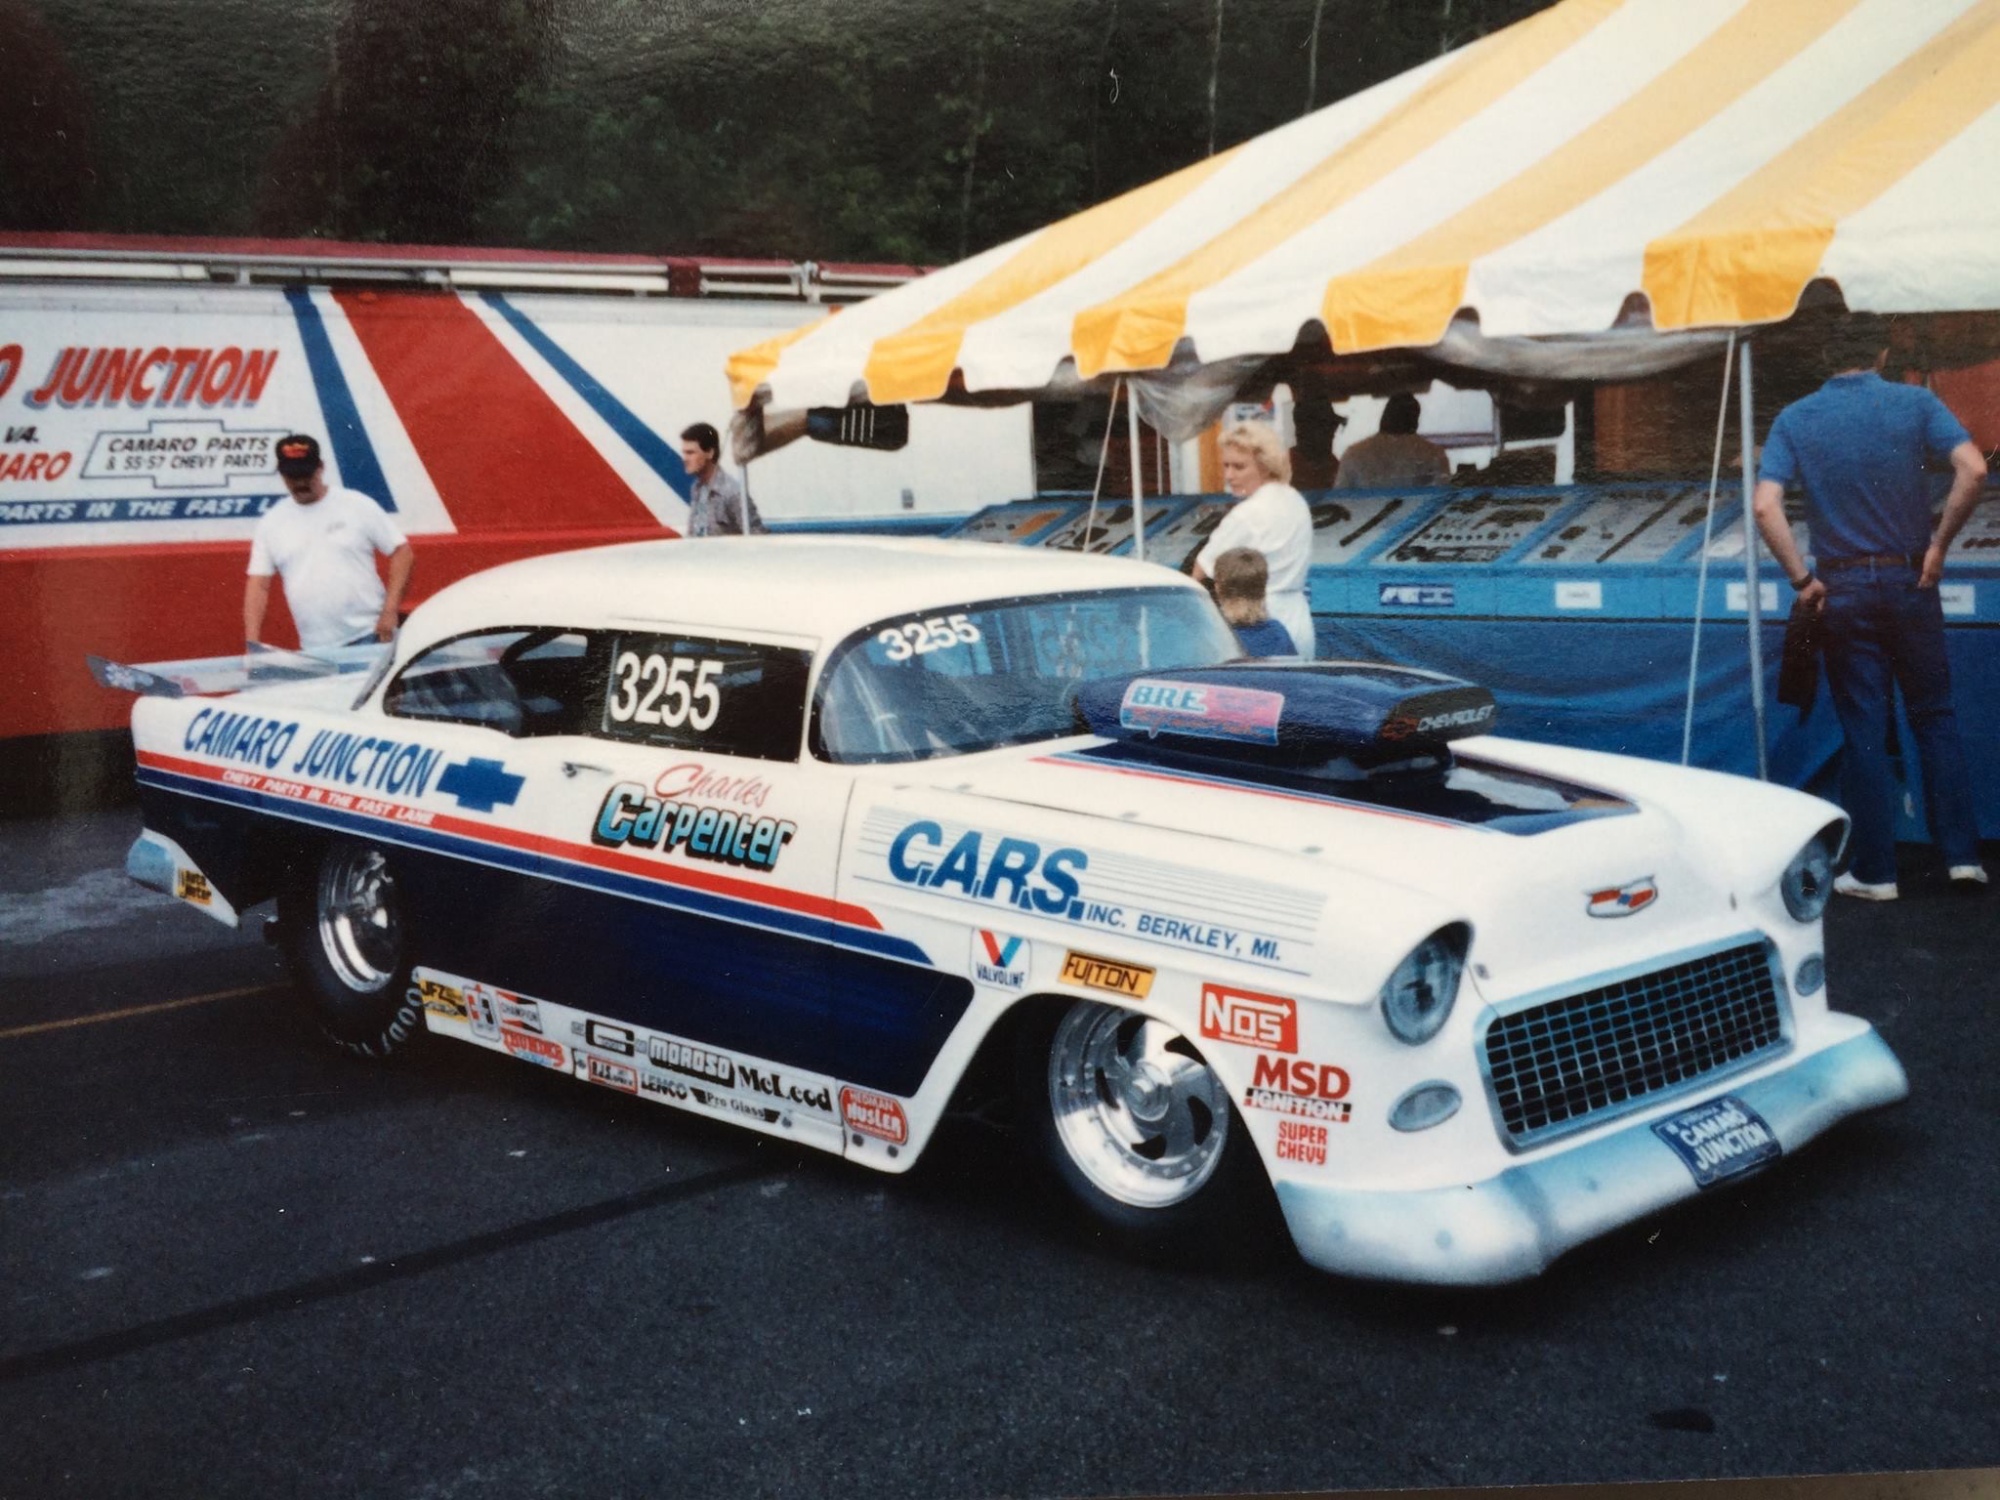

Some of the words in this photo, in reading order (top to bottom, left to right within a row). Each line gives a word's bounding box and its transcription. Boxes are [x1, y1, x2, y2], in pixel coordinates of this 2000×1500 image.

[24, 346, 279, 410] JUNCTION
[105, 456, 116, 470] &
[170, 454, 217, 469] CHEVY
[222, 453, 267, 468] PARTS
[108, 437, 197, 454] CAMARO
[206, 436, 270, 451] PARTS
[86, 500, 116, 518] IN
[128, 499, 175, 517] THE
[184, 497, 250, 516] FAST
[877, 614, 980, 660] 3255
[609, 651, 724, 731] 3255
[1416, 704, 1496, 732] CHEVROLET
[184, 707, 299, 769] CAMARO
[293, 728, 444, 799] JUNCTION
[221, 770, 260, 788] CHEVY
[263, 779, 304, 798] PARTS
[306, 788, 323, 801] IN
[326, 793, 351, 809] THE
[356, 798, 392, 817] FAST
[394, 806, 435, 826] LANE
[654, 763, 773, 808] Charles
[591, 780, 799, 873] Carpenter
[1086, 903, 1127, 929] INC.
[1137, 915, 1241, 952] BERKLEY,
[1250, 938, 1282, 962] MI.
[975, 963, 1025, 989] VALVOLINE
[1064, 957, 1141, 992] FULTON
[1204, 990, 1291, 1043] NOS
[650, 1037, 735, 1088] MOROSO
[1253, 1054, 1351, 1101] MSD
[641, 1073, 688, 1100] LENCO
[706, 1090, 727, 1106] Pro
[730, 1099, 766, 1119] Glass
[738, 1065, 833, 1113] McLeod
[1252, 1090, 1344, 1120] IGNITION
[1278, 1120, 1328, 1146] SUPER
[1680, 1108, 1748, 1147] CAMARO
[1694, 1123, 1769, 1171] JUNCTION
[1276, 1140, 1327, 1165] CHEVY
